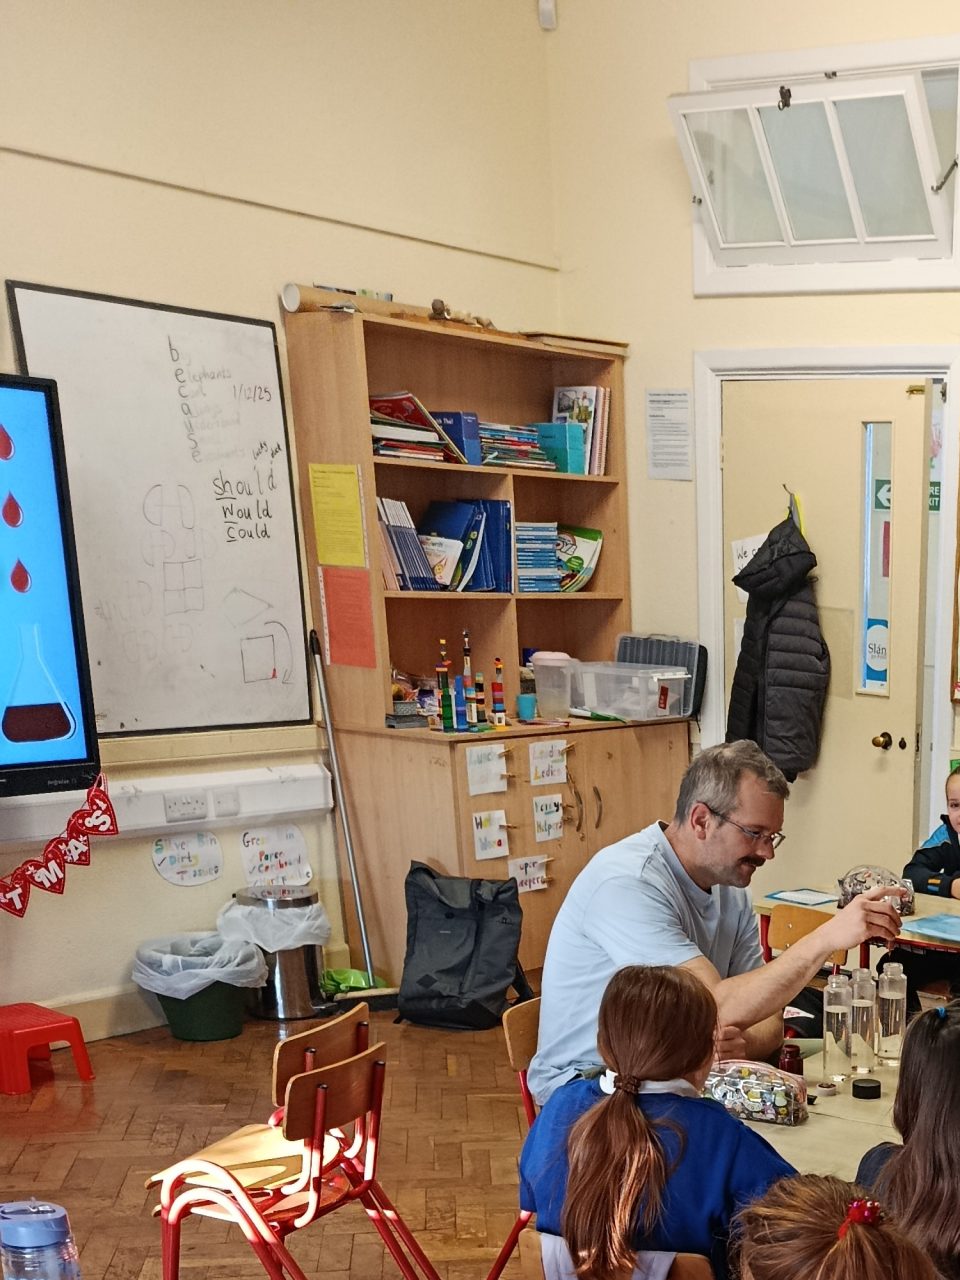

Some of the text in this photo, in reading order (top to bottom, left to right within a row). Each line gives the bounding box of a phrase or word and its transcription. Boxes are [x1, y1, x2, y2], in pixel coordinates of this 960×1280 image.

[233, 384, 272, 402] 1/12/25
[736, 545, 748, 560] We
[868, 643, 886, 654] Slán
